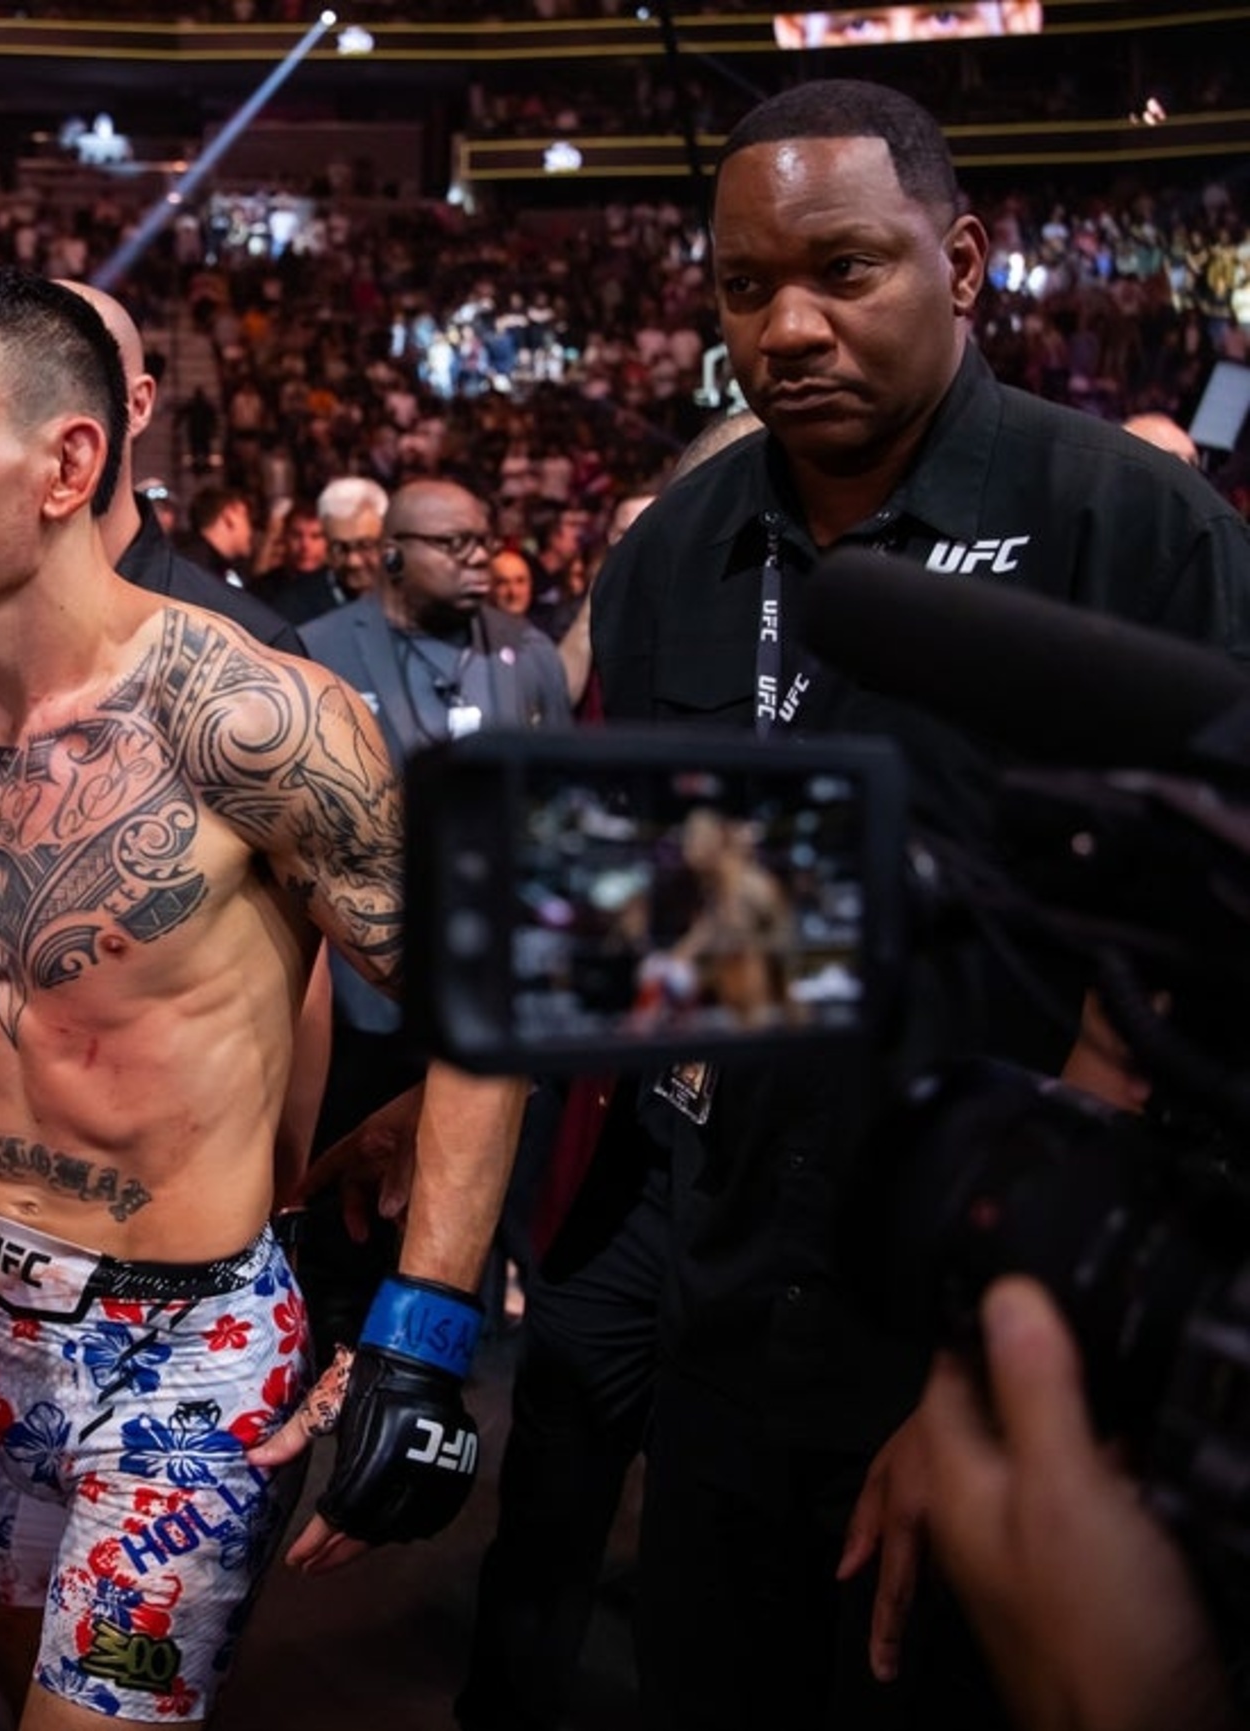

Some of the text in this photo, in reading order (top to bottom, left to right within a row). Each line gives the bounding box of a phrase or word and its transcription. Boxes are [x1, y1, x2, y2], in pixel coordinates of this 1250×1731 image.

[925, 535, 1031, 574] UFC
[760, 600, 778, 642] UFC
[757, 675, 777, 720] UFC
[778, 672, 810, 722] UFC
[406, 1417, 478, 1475] UFC
